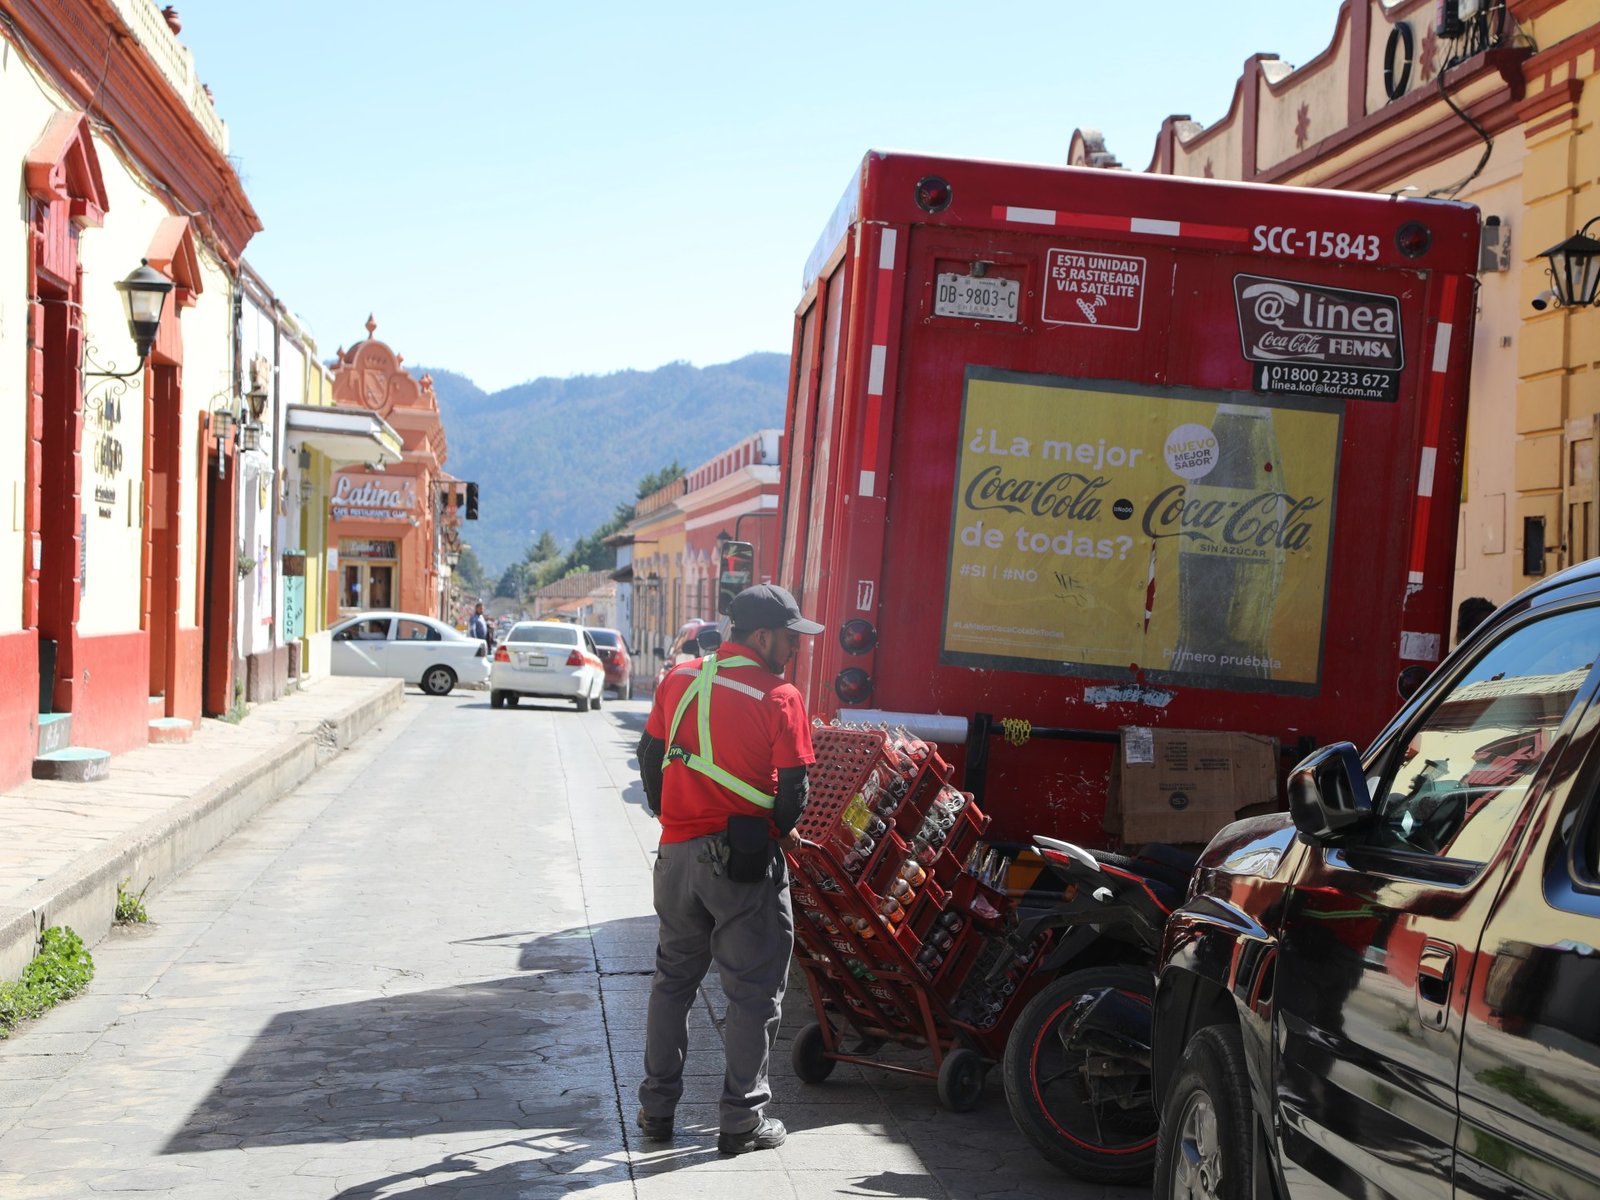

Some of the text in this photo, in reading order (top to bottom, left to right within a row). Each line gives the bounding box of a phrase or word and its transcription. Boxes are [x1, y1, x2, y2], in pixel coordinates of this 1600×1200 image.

[1252, 224, 1381, 262] SCC-15843
[1057, 254, 1139, 273] ESTA UNIDAD
[1052, 266, 1140, 286] ES RASTREADA
[939, 284, 1016, 309] DB-9803-C
[1056, 277, 1135, 298] VÍA SATÉLITE
[1328, 337, 1393, 359] FEMSA
[1272, 366, 1390, 389] 01800 2233 672
[1271, 379, 1383, 398] linea.kof@kof.com.mx
[969, 427, 1144, 470] ¿La mejor
[1167, 436, 1216, 454] NUEVO
[1174, 449, 1211, 462] MEJOR
[331, 476, 416, 508] Latino's
[960, 519, 1133, 561] de todas?
[1200, 543, 1267, 558] SIN AZÚCAR
[1220, 655, 1282, 669] pruébala
